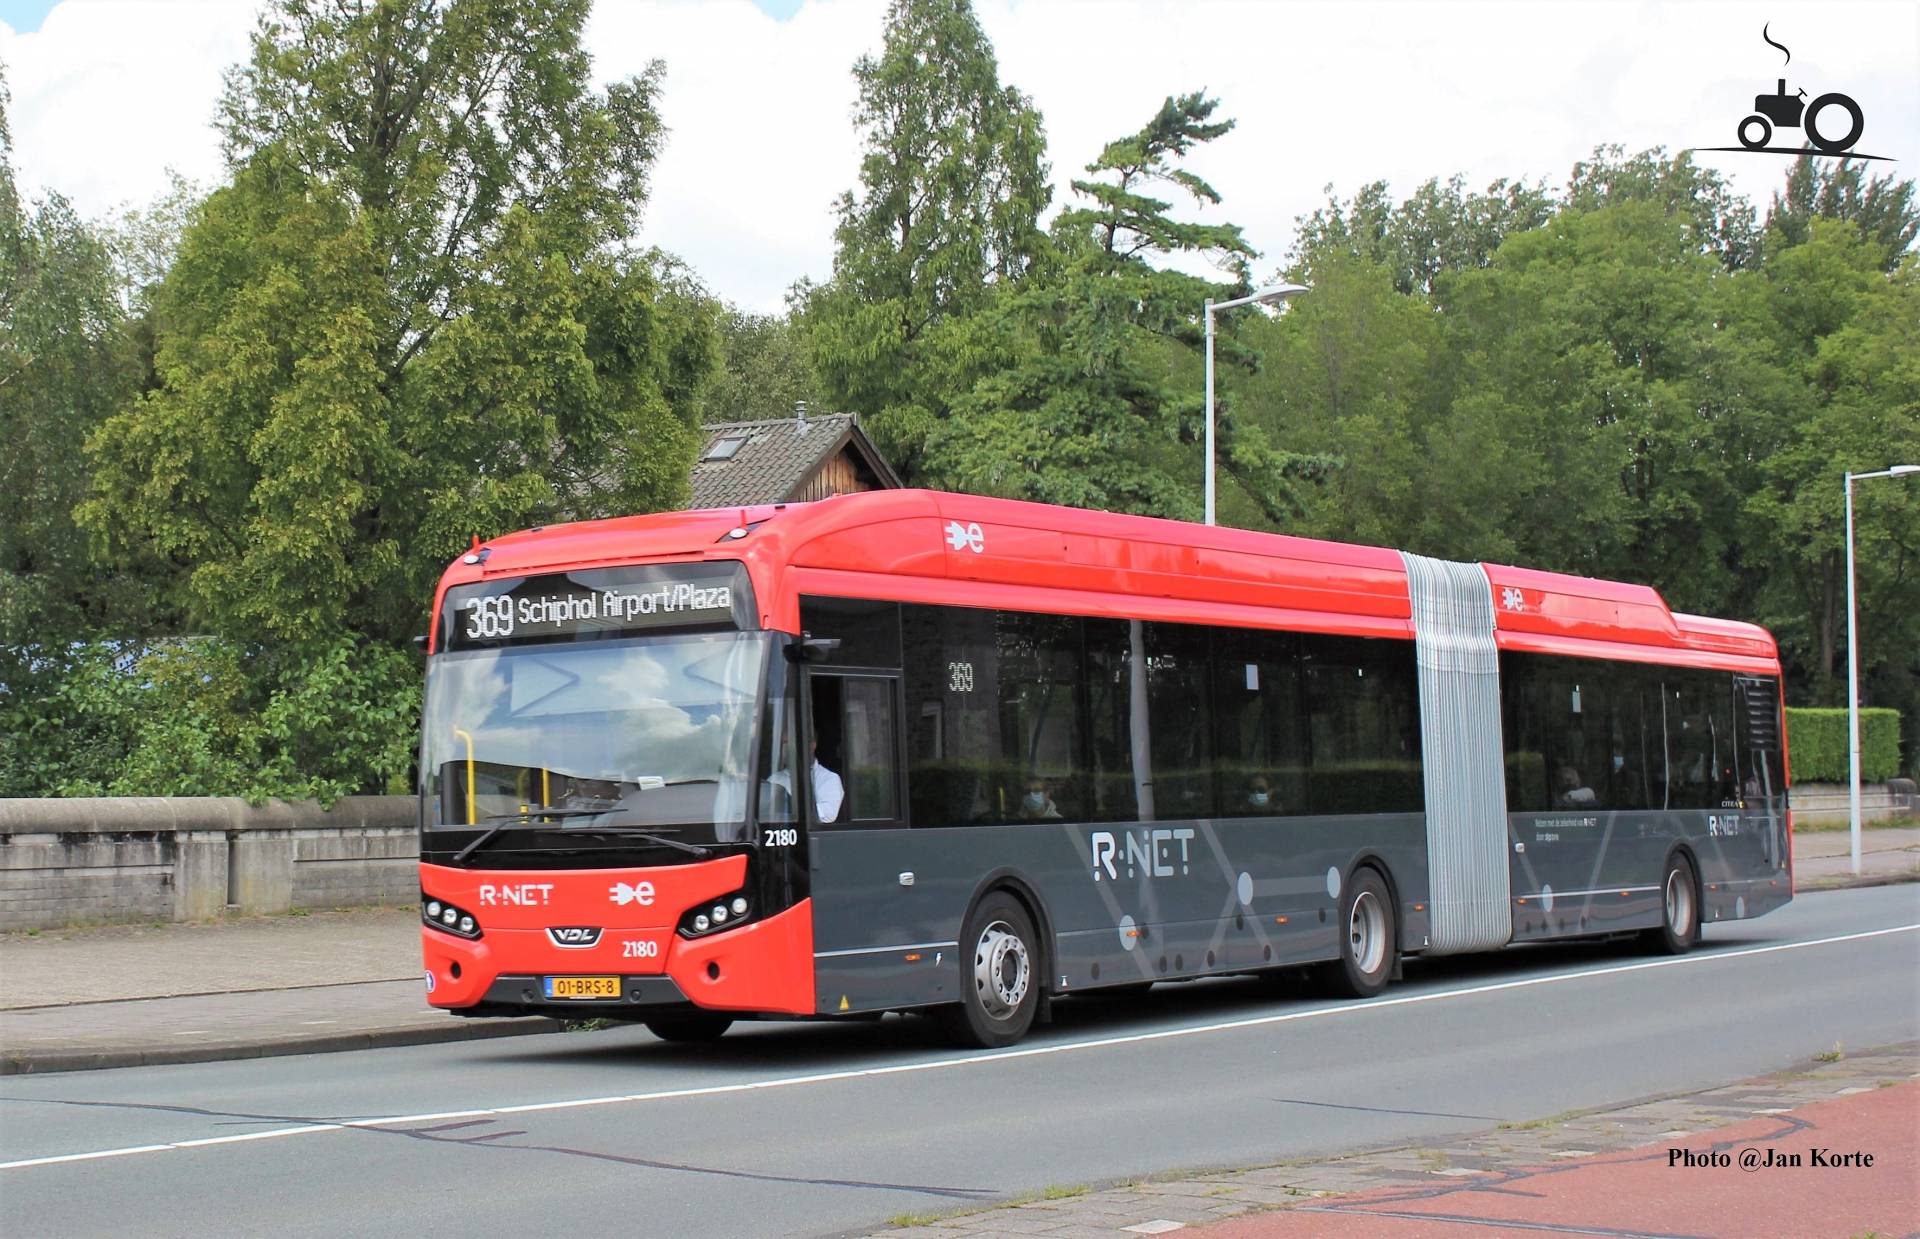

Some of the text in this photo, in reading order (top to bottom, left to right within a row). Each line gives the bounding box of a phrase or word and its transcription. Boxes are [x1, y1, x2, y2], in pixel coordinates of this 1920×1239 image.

[466, 583, 731, 639] 369 Schiphol Airport/Plaza
[948, 661, 974, 692] 369
[764, 829, 798, 847] 2180
[554, 928, 594, 941] VDL
[622, 941, 658, 958] 2180
[557, 980, 614, 994] 01-BRS-8
